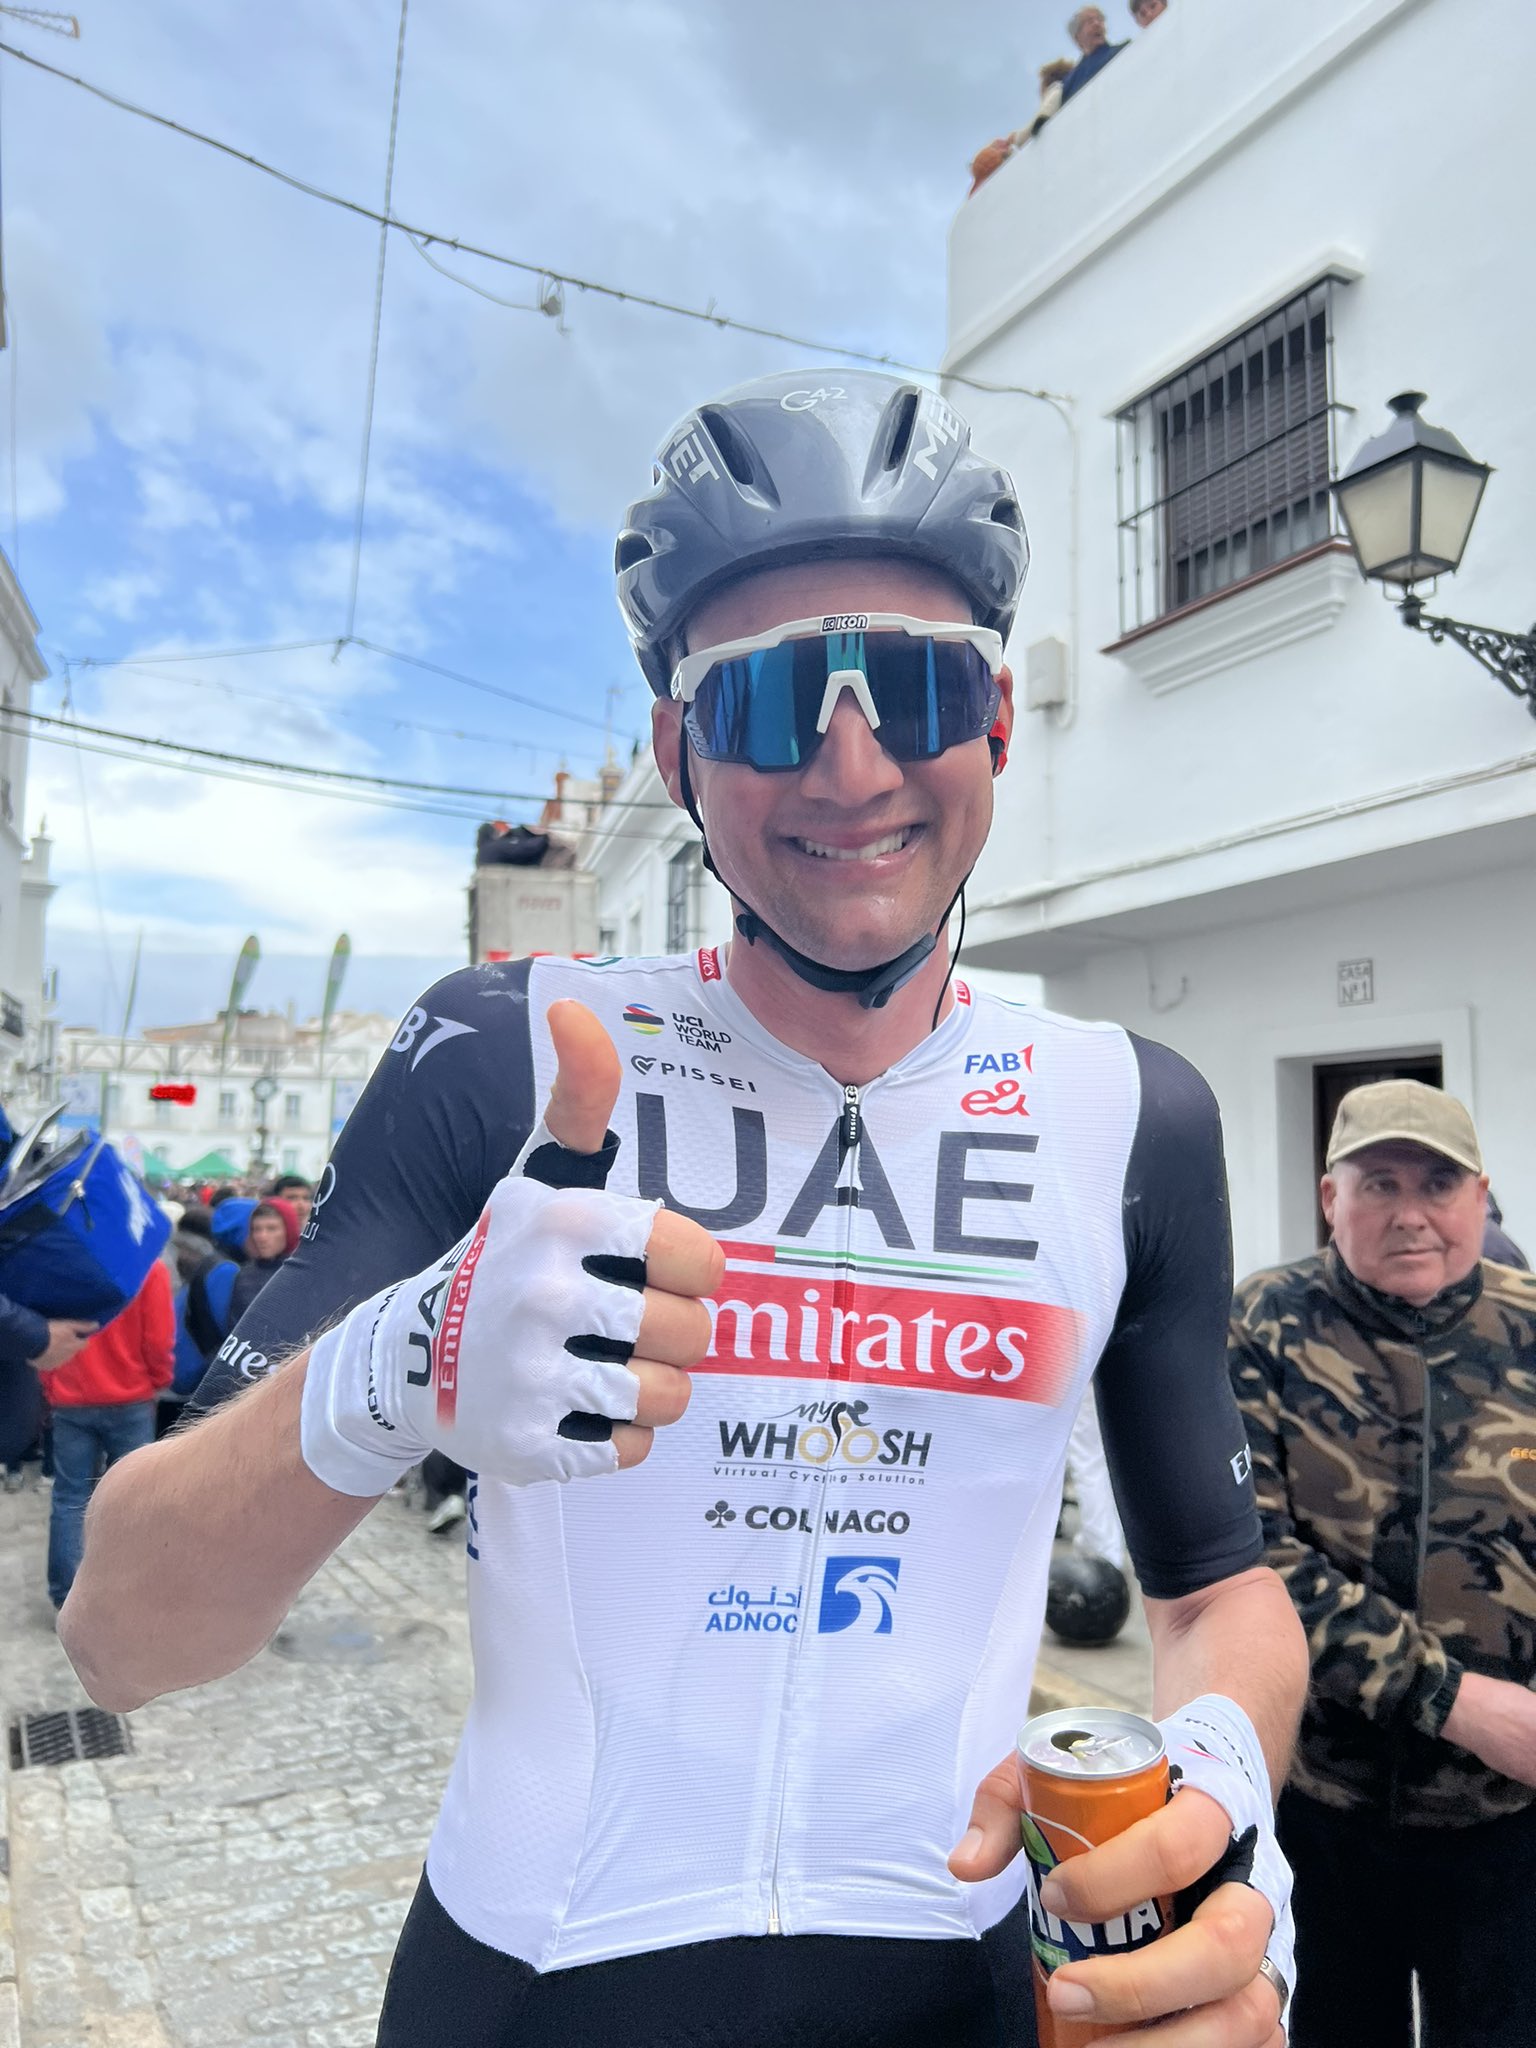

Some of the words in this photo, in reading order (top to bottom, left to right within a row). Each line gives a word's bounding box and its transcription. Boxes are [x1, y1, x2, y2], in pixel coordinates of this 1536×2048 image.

[913, 397, 960, 480] ME
[671, 1012, 704, 1028] UCI
[674, 1022, 732, 1044] WORLD
[675, 1032, 722, 1054] TEAM
[660, 1062, 757, 1093] PISSEI
[635, 1091, 1041, 1261] UAE
[406, 1239, 472, 1388] UAE
[439, 1235, 487, 1390] Emirates
[700, 1288, 1029, 1383] mirates
[718, 1420, 933, 1468] WHOOSH
[713, 1466, 777, 1478] Virtual
[858, 1472, 926, 1486] Solution
[704, 1611, 798, 1634] ADNOC
